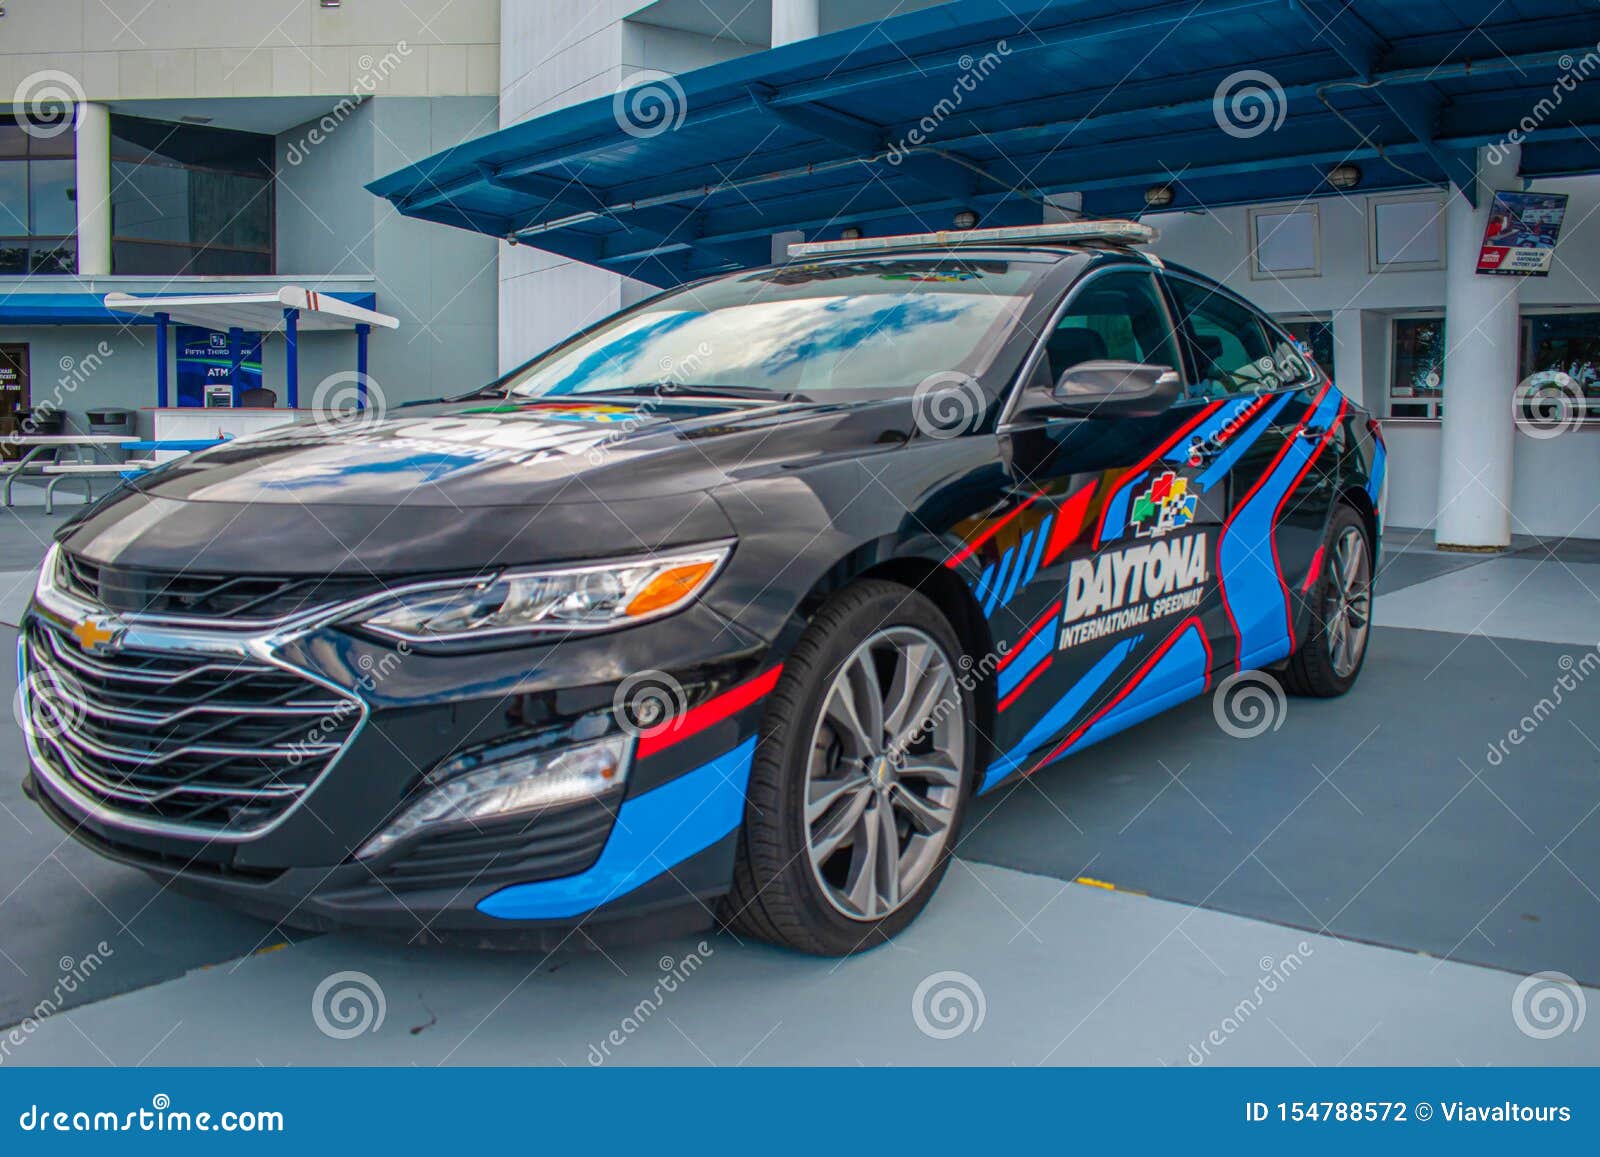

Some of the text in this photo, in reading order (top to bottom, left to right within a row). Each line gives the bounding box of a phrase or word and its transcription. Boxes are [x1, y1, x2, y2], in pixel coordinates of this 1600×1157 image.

[207, 368, 229, 377] ATM
[1063, 532, 1207, 624] DAYTONA
[1059, 587, 1204, 650] INTERNATIONAL SPEEDWAY
